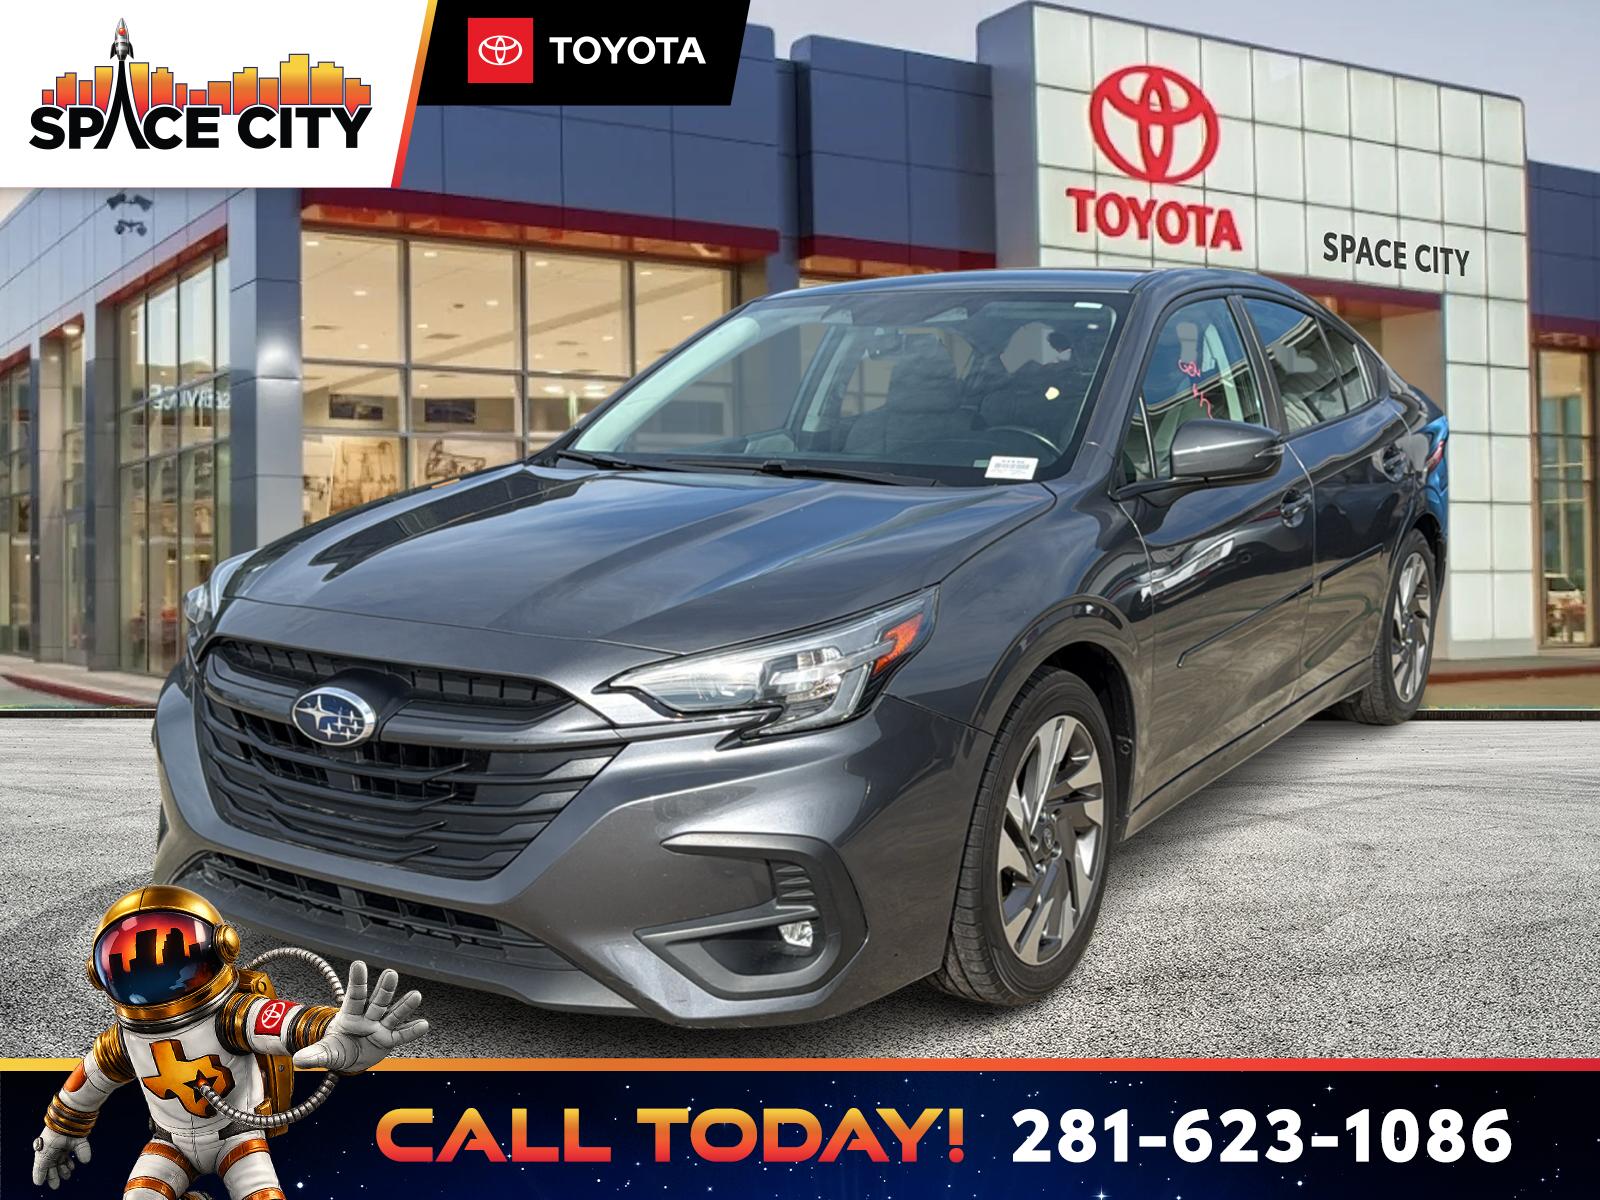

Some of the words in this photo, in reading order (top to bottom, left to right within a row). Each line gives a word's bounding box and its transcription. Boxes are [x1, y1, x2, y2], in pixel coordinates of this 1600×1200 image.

[1066, 187, 1243, 252] TOYOTA
[1322, 231, 1408, 270] SPACE
[1413, 243, 1471, 277] CITY
